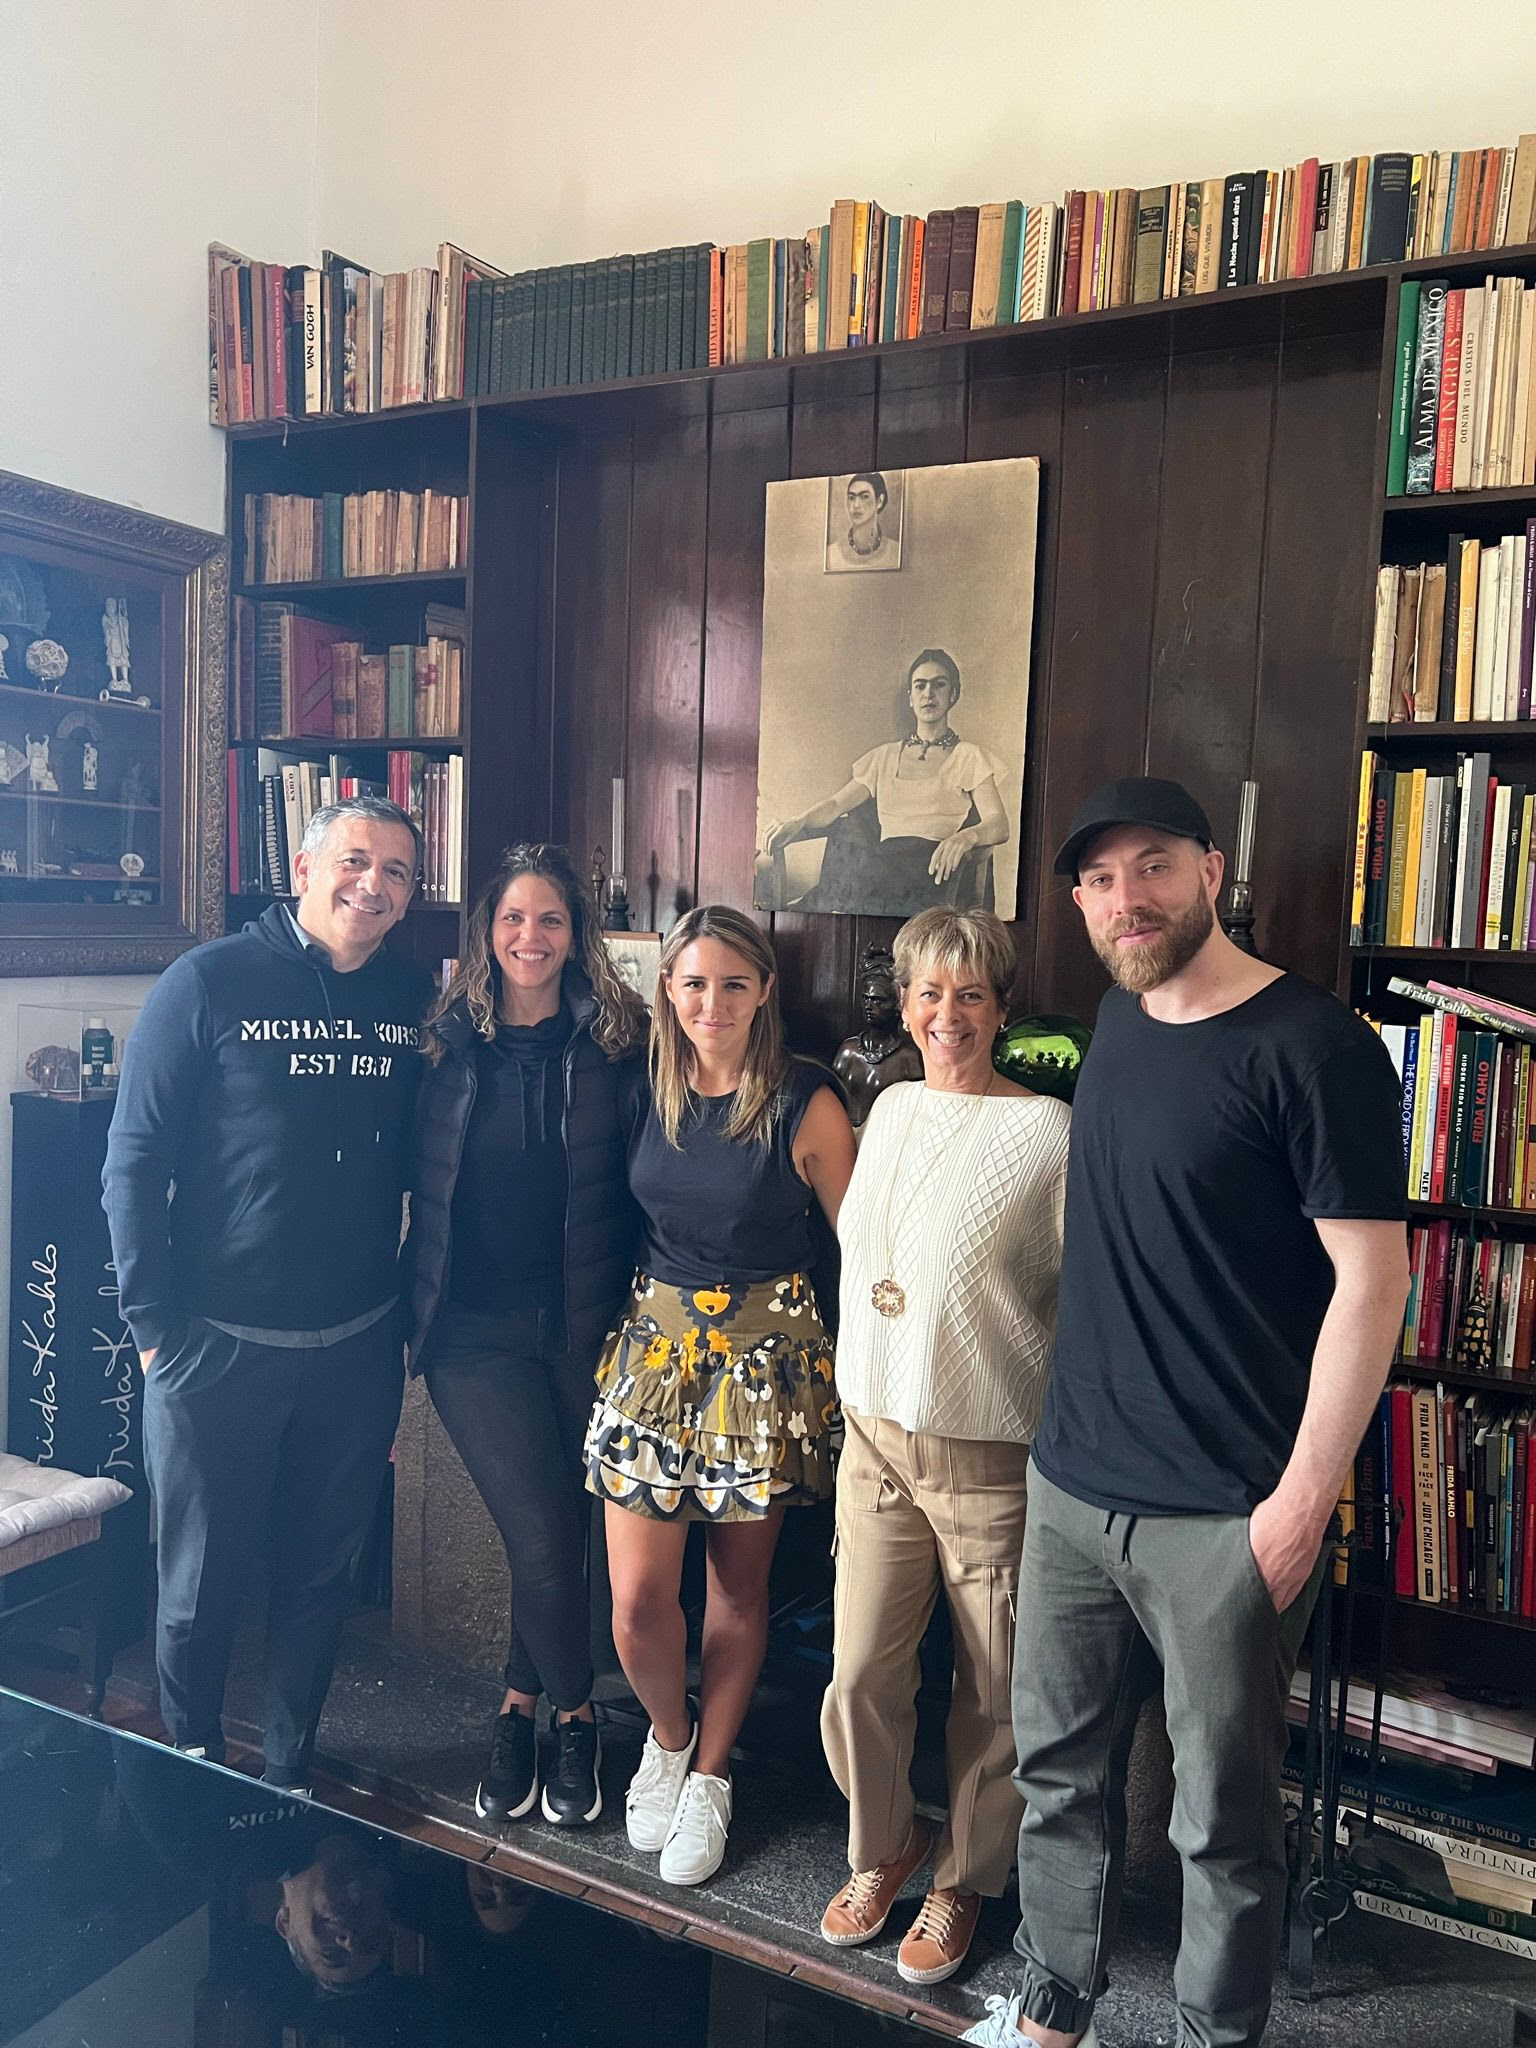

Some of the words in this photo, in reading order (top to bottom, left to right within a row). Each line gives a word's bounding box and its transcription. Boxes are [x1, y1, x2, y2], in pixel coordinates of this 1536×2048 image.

[1205, 223, 1213, 253] VIVIMOS
[1229, 242, 1238, 267] Noche
[913, 273, 919, 282] DE
[1228, 267, 1236, 278] La
[306, 304, 314, 340] GOGH
[306, 346, 314, 370] VAN
[1464, 332, 1475, 375] CRISTOS
[1422, 368, 1435, 391] DE
[1441, 338, 1461, 424] INGRES
[1463, 380, 1473, 399] DEL
[1415, 398, 1436, 450] ALMA
[1460, 405, 1470, 444] MUNDO
[1463, 607, 1473, 627] Frida
[1463, 629, 1472, 656] Kahlo
[1375, 799, 1387, 843] KAHLO
[1356, 839, 1364, 869] FRIDA
[1396, 823, 1405, 857] Finding
[1372, 848, 1386, 880] FRIDA
[1394, 860, 1404, 882] Frida
[1391, 885, 1401, 912] Kahlo
[1404, 981, 1437, 1006] Frida
[1436, 993, 1472, 1018] Kahlo
[241, 1019, 362, 1041] MICHAEL
[289, 1053, 341, 1075] EST
[1406, 1063, 1415, 1079] THE
[1403, 1080, 1414, 1109] WORLD
[1476, 1061, 1489, 1104] KAHLO
[1402, 1110, 1411, 1123] OF
[1473, 1108, 1484, 1143] FRIDA
[22, 1244, 57, 1377] Kahlo
[30, 1370, 59, 1465] rida
[1420, 1402, 1429, 1429] FRIDA
[1420, 1431, 1430, 1459] KAHLO
[1419, 1471, 1434, 1480] FACE
[1419, 1481, 1434, 1490] FACE
[1422, 1501, 1433, 1525] JUDY
[1447, 1490, 1455, 1518] KAHLO
[1423, 1527, 1433, 1564] CHICAGO
[1393, 1801, 1429, 1817] ATLAS
[1431, 1811, 1448, 1822] OF
[1451, 1816, 1474, 1830] THE
[1476, 1822, 1521, 1844] WORLD
[1446, 1840, 1536, 1879] PINTURA
[1424, 1914, 1535, 1957] MEXICANA
